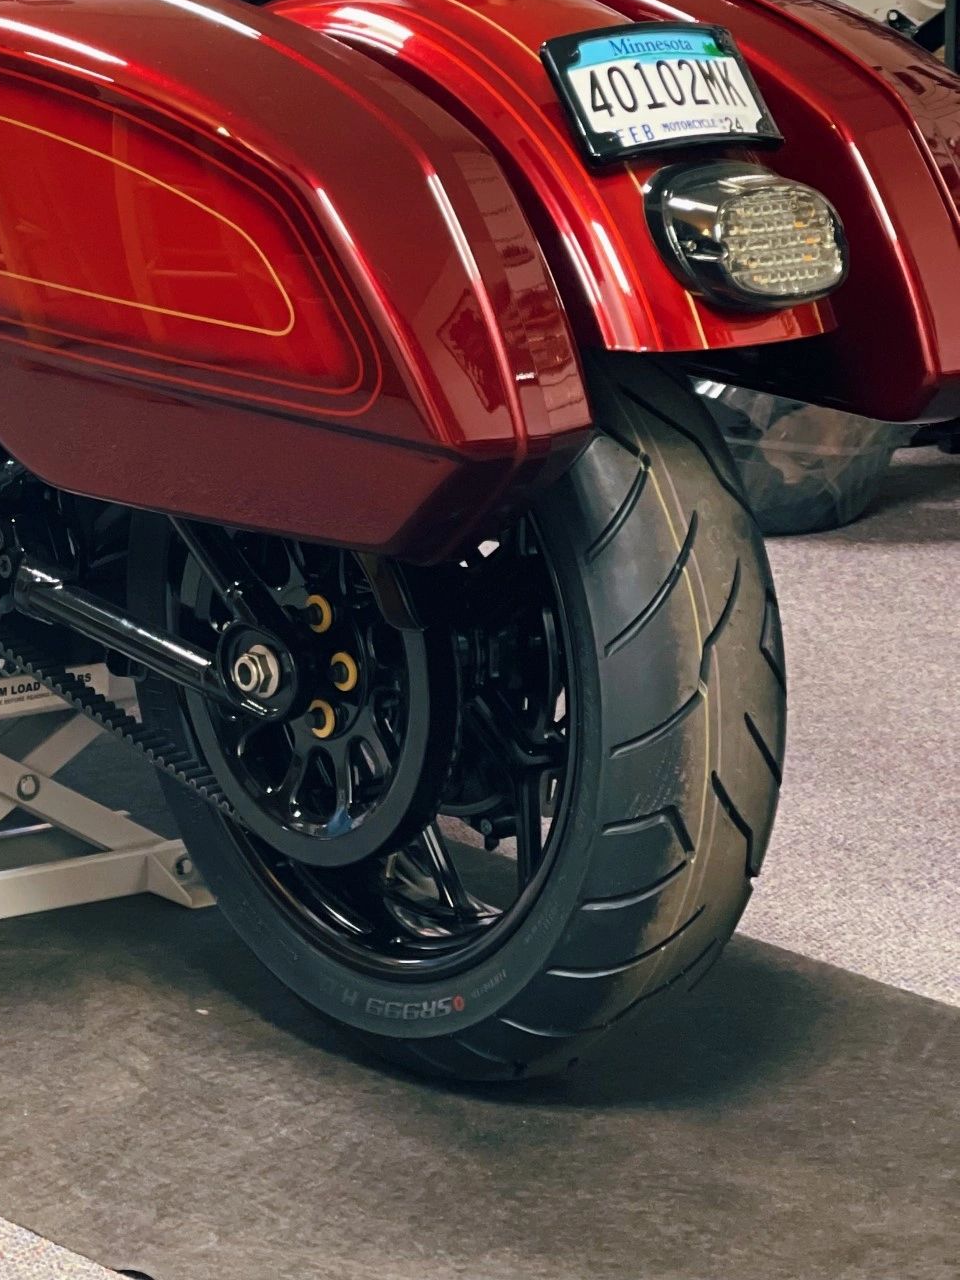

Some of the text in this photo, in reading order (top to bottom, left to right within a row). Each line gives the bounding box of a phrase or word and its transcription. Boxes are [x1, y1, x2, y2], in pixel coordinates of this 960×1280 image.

[610, 39, 693, 56] Minnesota
[589, 58, 748, 118] 40102MK
[662, 118, 717, 133] MOTORCYCLE
[10, 681, 41, 695] LOAD
